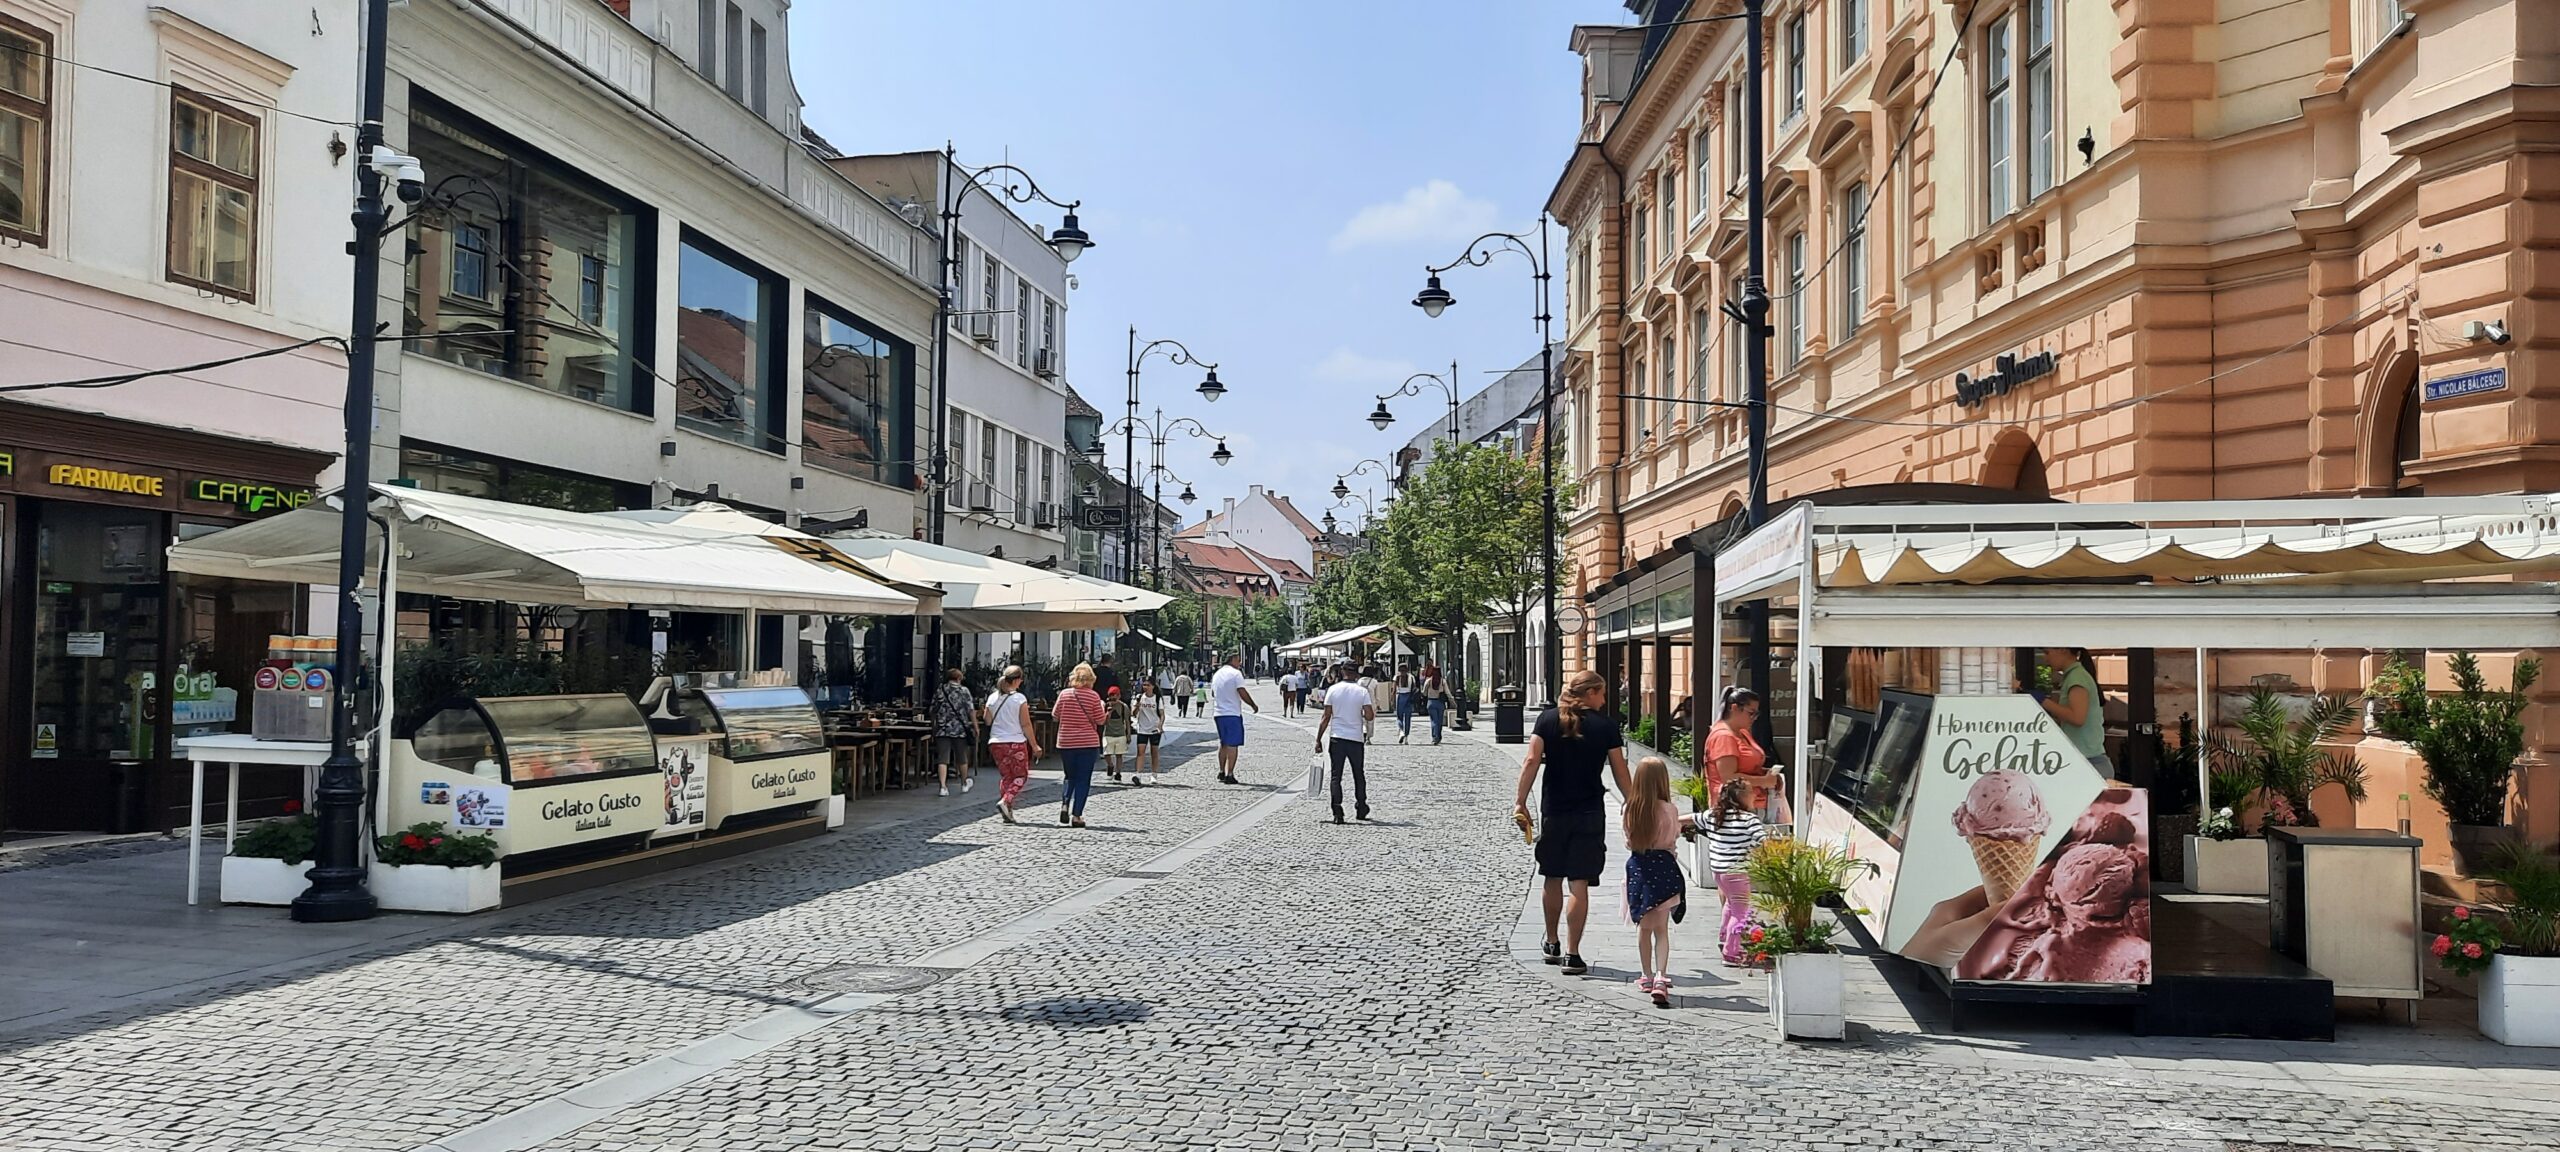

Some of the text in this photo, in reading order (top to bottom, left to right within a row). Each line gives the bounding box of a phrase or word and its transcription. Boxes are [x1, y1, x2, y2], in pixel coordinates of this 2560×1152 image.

[2426, 386, 2438, 398] Str.
[2438, 380, 2467, 396] NICOLAE
[50, 464, 164, 497] FARMACIE
[1937, 711, 2049, 736] Homemade
[1942, 735, 2070, 780] Gelato
[752, 768, 816, 790] Gelato Gusto
[542, 793, 641, 821] Gelato Gusto
